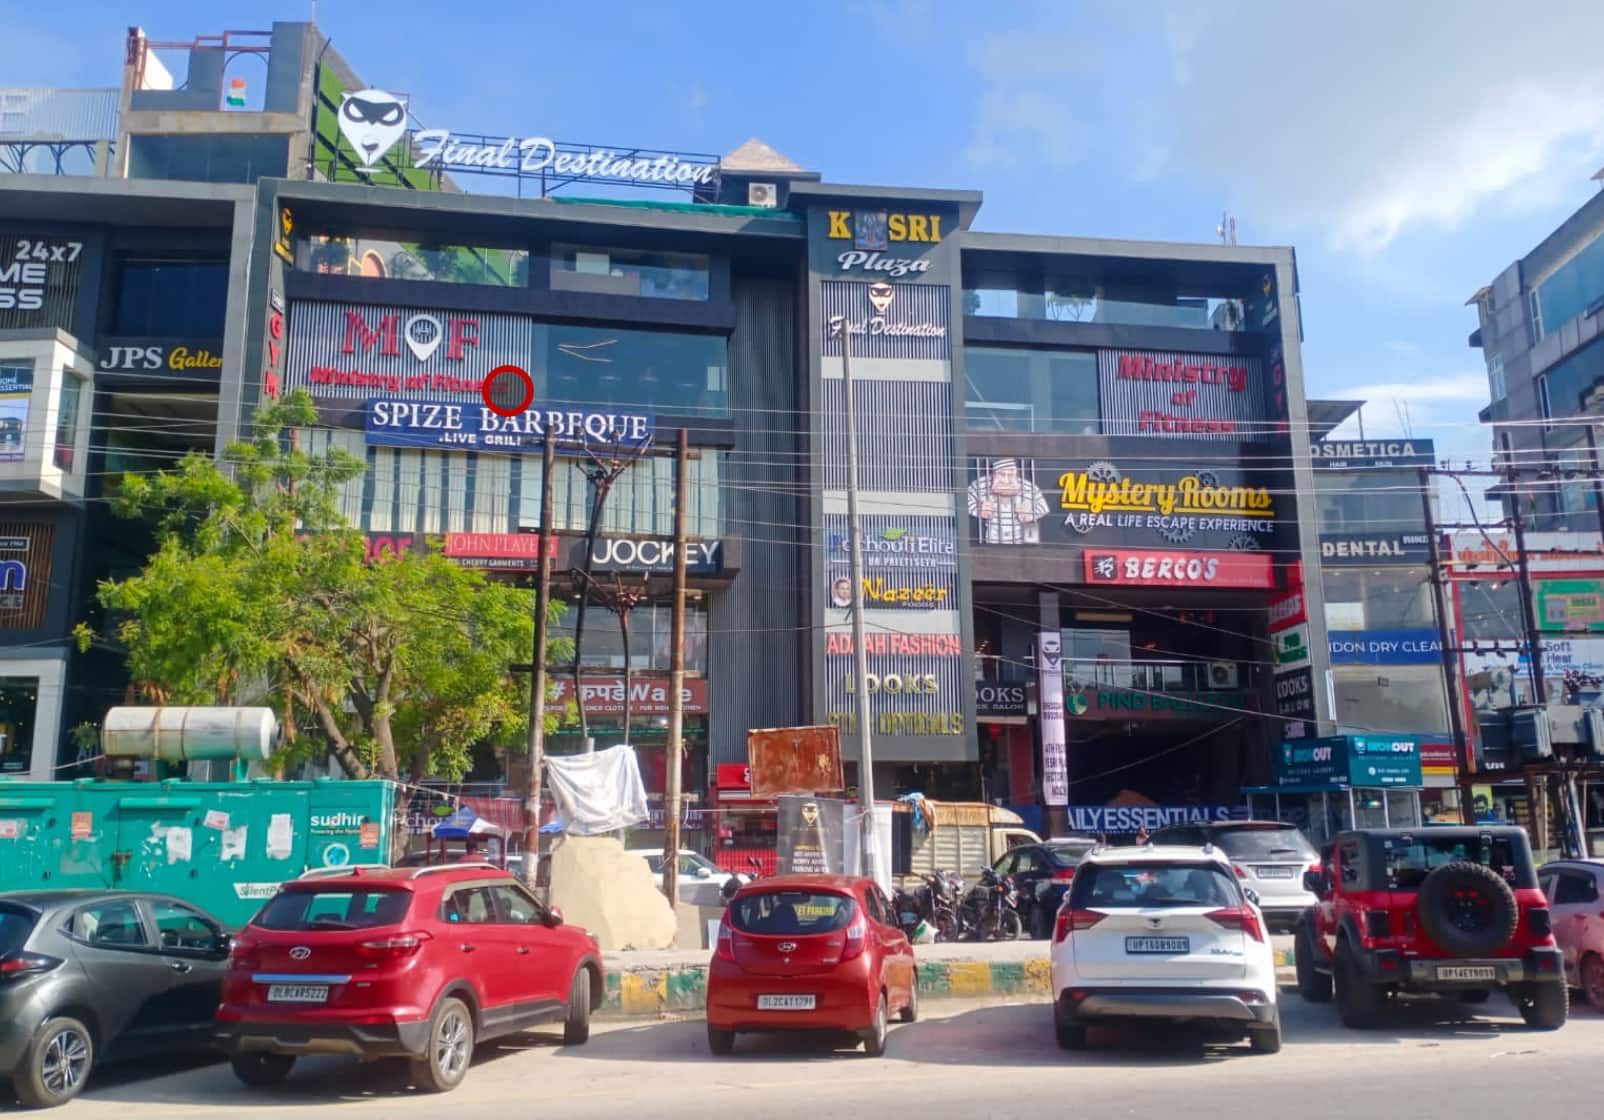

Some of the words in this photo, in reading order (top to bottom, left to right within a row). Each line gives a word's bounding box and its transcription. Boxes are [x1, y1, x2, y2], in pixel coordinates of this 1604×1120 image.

[411, 128, 514, 169] Final
[518, 136, 713, 184] Destination
[15, 240, 83, 262] 24x7
[837, 250, 930, 277] Plaza
[870, 316, 945, 338] Destination
[100, 347, 163, 369] JPS
[264, 313, 283, 400] GYM
[310, 366, 400, 392] Ministry
[405, 373, 428, 390] of
[1119, 354, 1247, 393] Ministry
[1172, 388, 1197, 406] of
[372, 401, 463, 430] SPIZE
[480, 407, 648, 443] BARBEQUE
[1138, 409, 1236, 434] Fitness
[1058, 472, 1175, 514] Mystery
[1178, 476, 1272, 509] Rooms
[1064, 513, 1075, 526] A
[1079, 514, 1112, 527] REAL
[1117, 515, 1142, 528] LIFE
[1146, 516, 1195, 530] ESCAPE
[1198, 518, 1273, 533] EXPERIENCE
[592, 539, 718, 565] JOCKEY
[1322, 541, 1404, 557] DENTAL
[1125, 557, 1219, 581] BERCO'S
[891, 633, 960, 655] FASHION
[1329, 641, 1365, 653] DON
[1369, 641, 1398, 653] DRY
[1402, 641, 1443, 653] CLEA
[845, 673, 939, 695] LOOKS
[976, 687, 1025, 703] OKS
